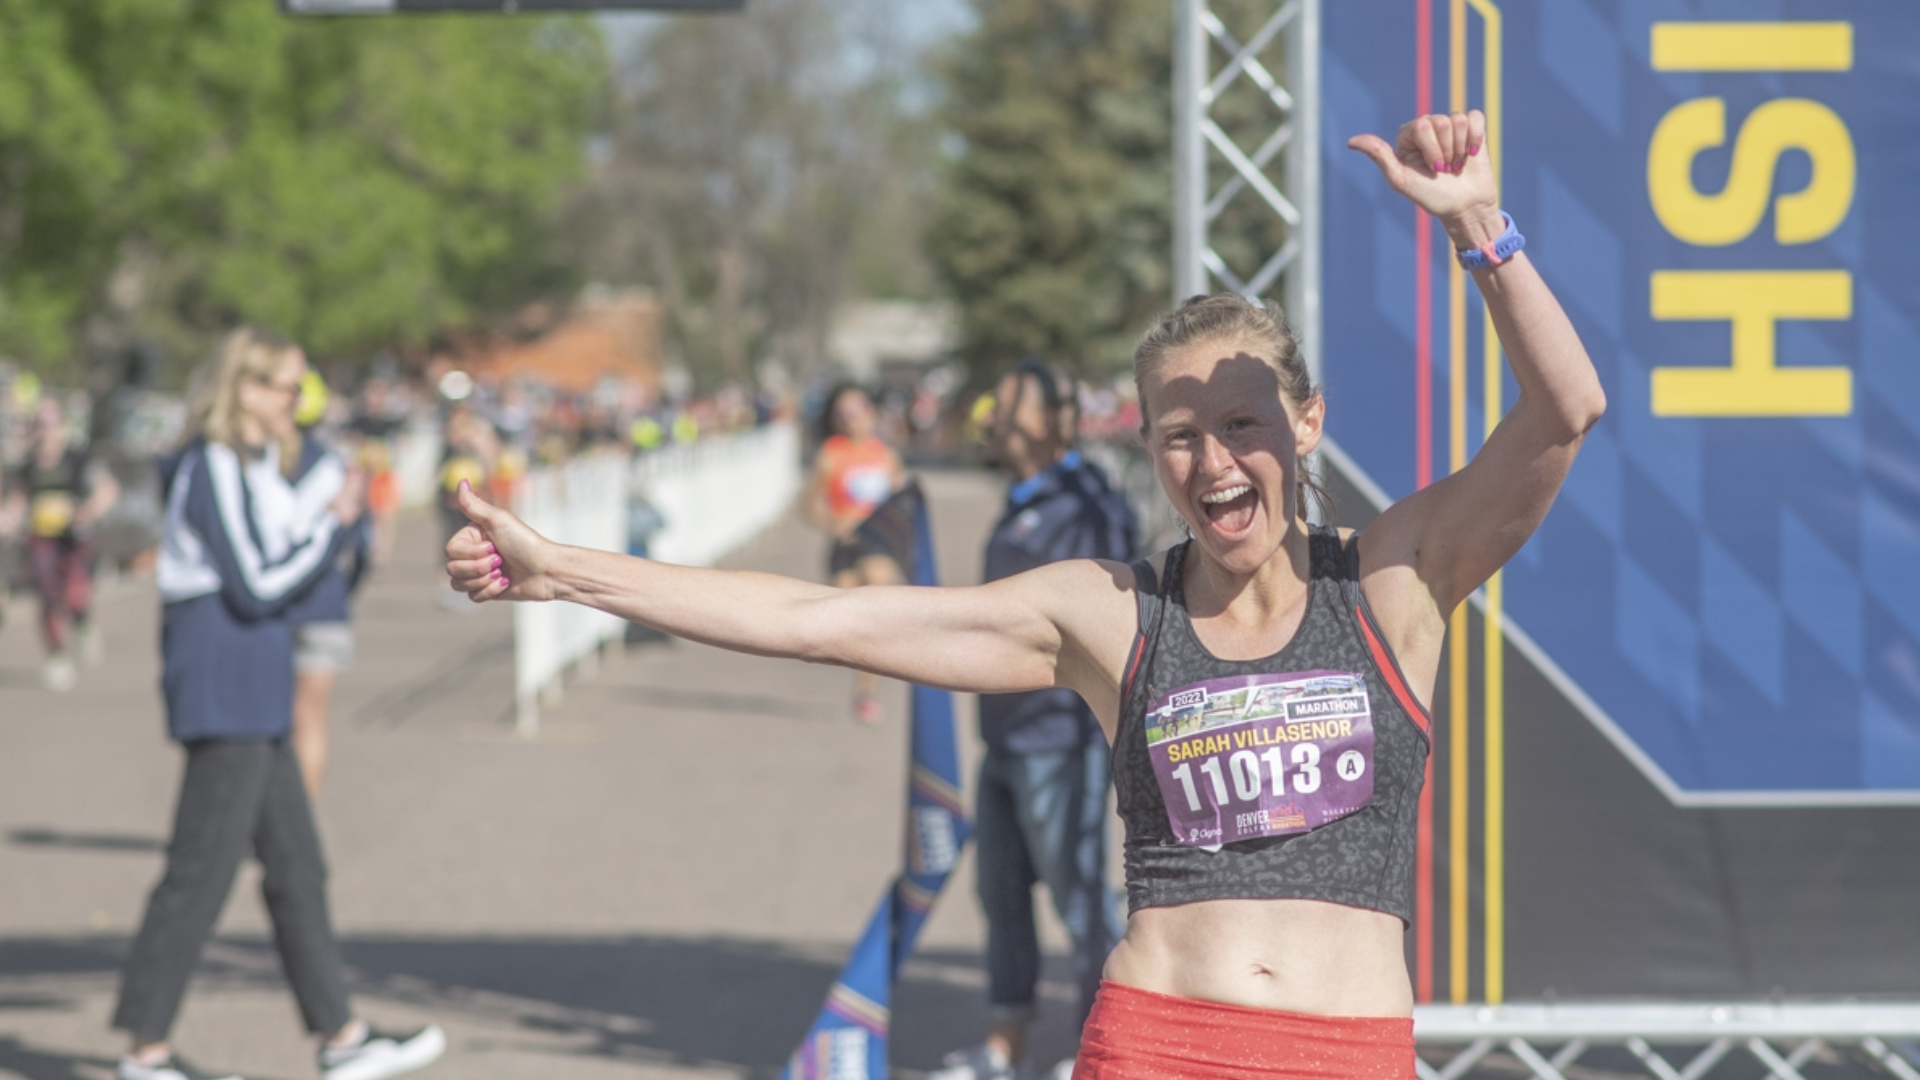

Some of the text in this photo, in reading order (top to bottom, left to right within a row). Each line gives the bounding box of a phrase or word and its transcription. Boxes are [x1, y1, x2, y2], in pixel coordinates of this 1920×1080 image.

[1174, 692, 1201, 707] 2022
[1295, 698, 1359, 715] MARATHON
[1167, 719, 1353, 763] SARAH VILLASENOR
[1345, 758, 1357, 775] A
[1171, 742, 1321, 812] 11013
[1236, 810, 1270, 828] DENVER
